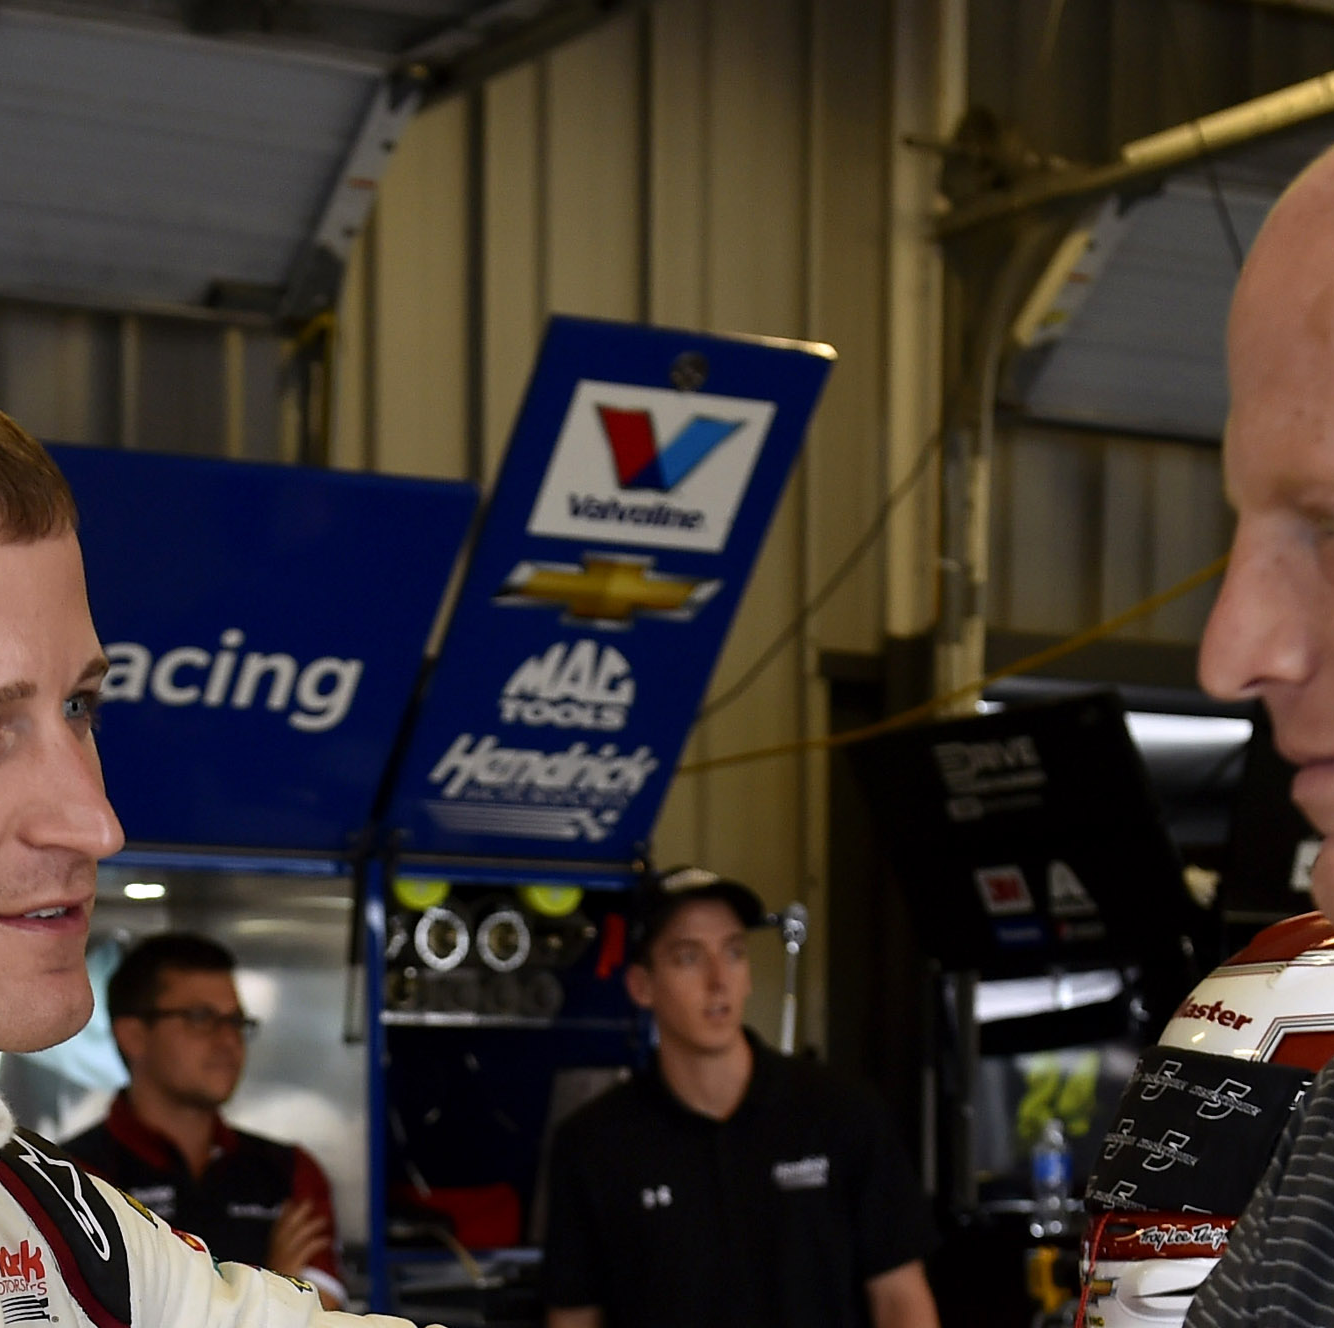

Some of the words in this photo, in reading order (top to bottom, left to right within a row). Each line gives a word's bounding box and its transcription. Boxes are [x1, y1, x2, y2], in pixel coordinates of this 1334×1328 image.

[569, 493, 705, 530] Valvoline
[98, 628, 364, 732] acing
[500, 697, 629, 732] TOOLS
[428, 733, 660, 799] Hendrick
